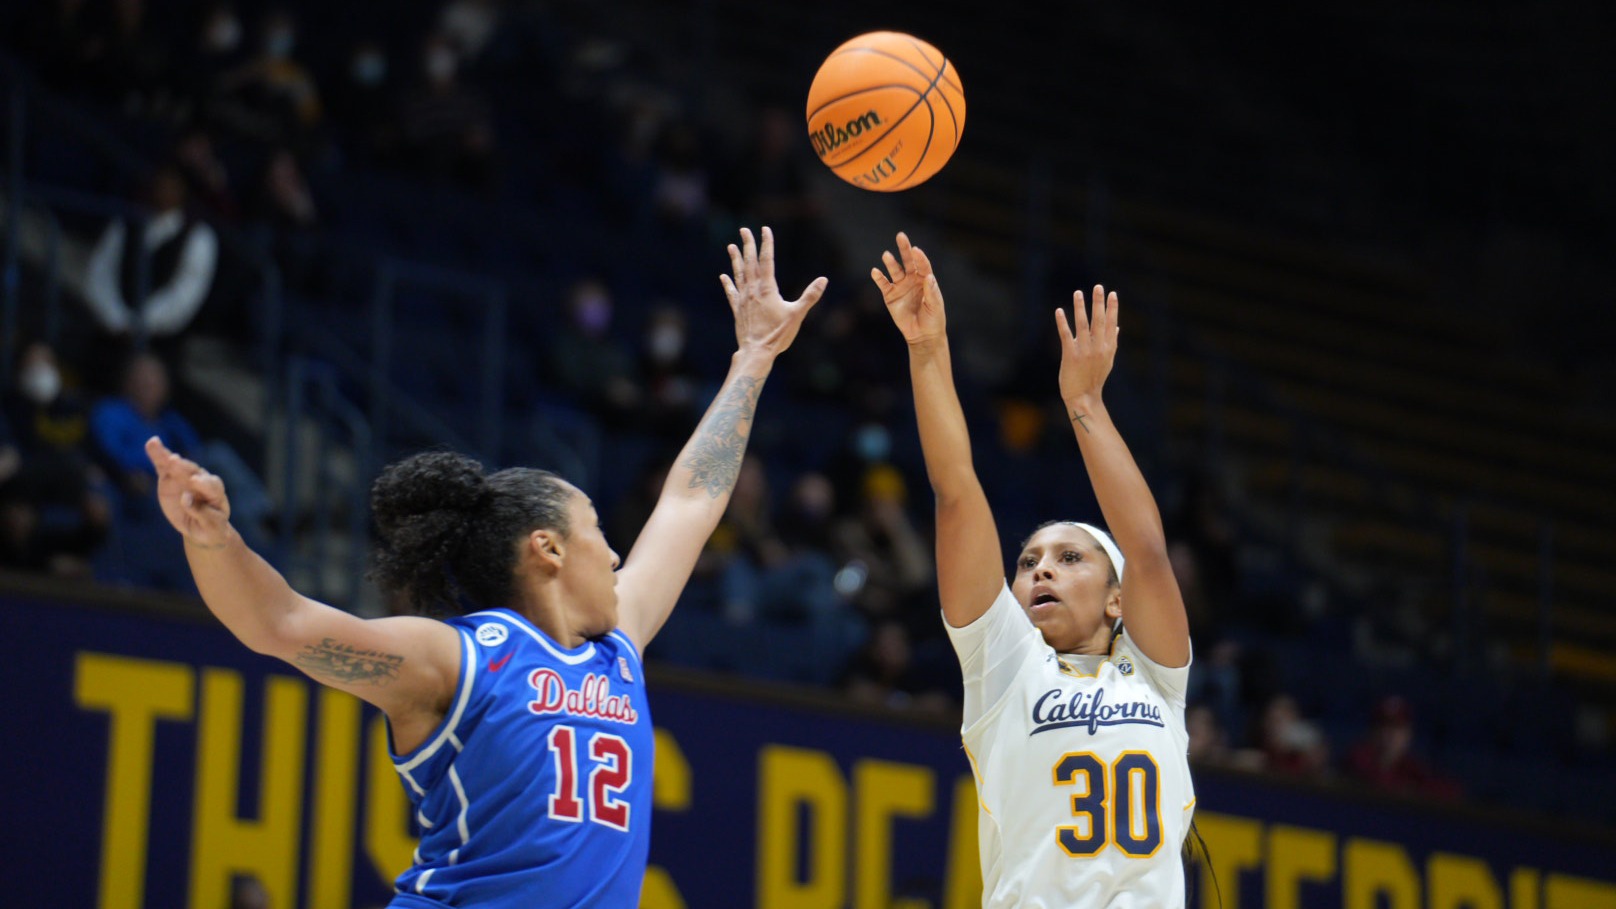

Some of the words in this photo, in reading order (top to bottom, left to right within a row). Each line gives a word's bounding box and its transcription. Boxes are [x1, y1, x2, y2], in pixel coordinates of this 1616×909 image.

[527, 667, 638, 725] Dallas
[1030, 687, 1165, 736] California
[547, 724, 633, 832] 12
[1052, 750, 1164, 858] 30
